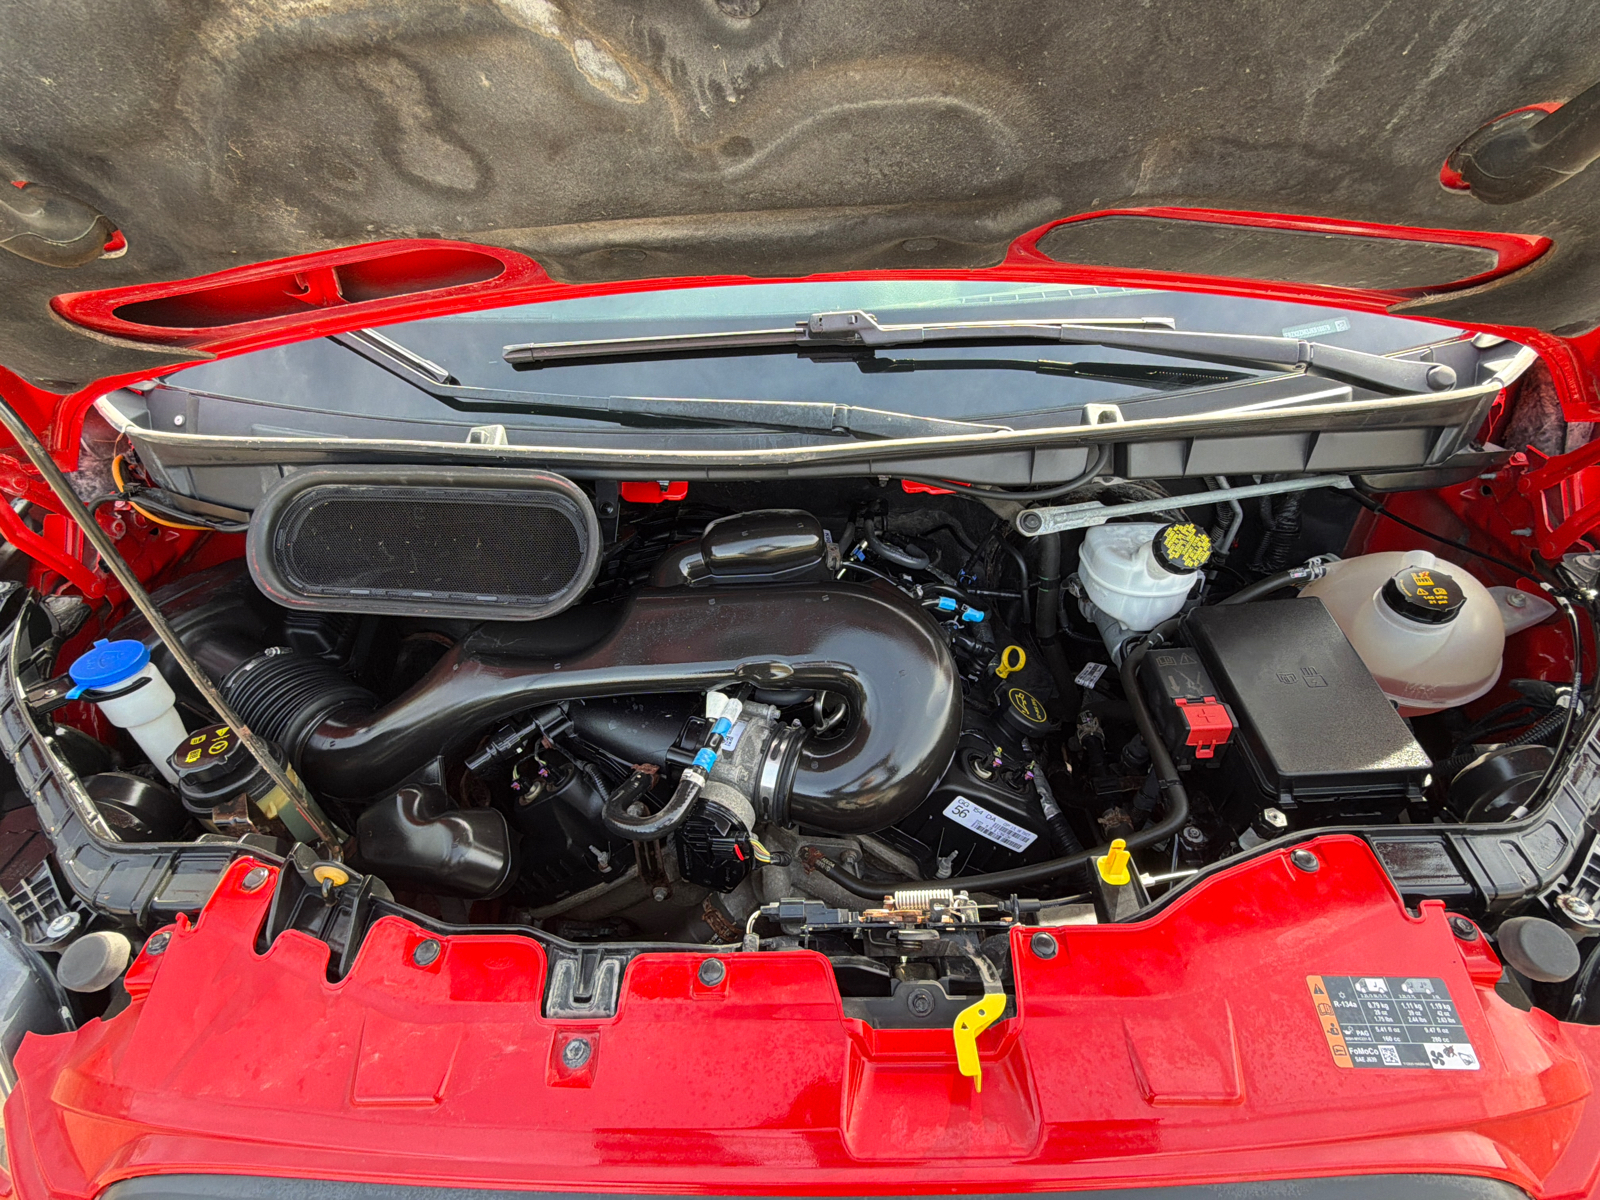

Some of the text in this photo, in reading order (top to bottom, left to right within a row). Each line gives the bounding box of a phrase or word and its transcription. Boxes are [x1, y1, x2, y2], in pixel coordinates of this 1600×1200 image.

[951, 805, 970, 819] 56
[958, 798, 970, 808] GG
[985, 814, 997, 822] DA
[1380, 1002, 1390, 1010] kg
[1414, 1003, 1423, 1011] kg
[1443, 1003, 1452, 1011] kg
[1348, 1047, 1379, 1055] FoMoCo
